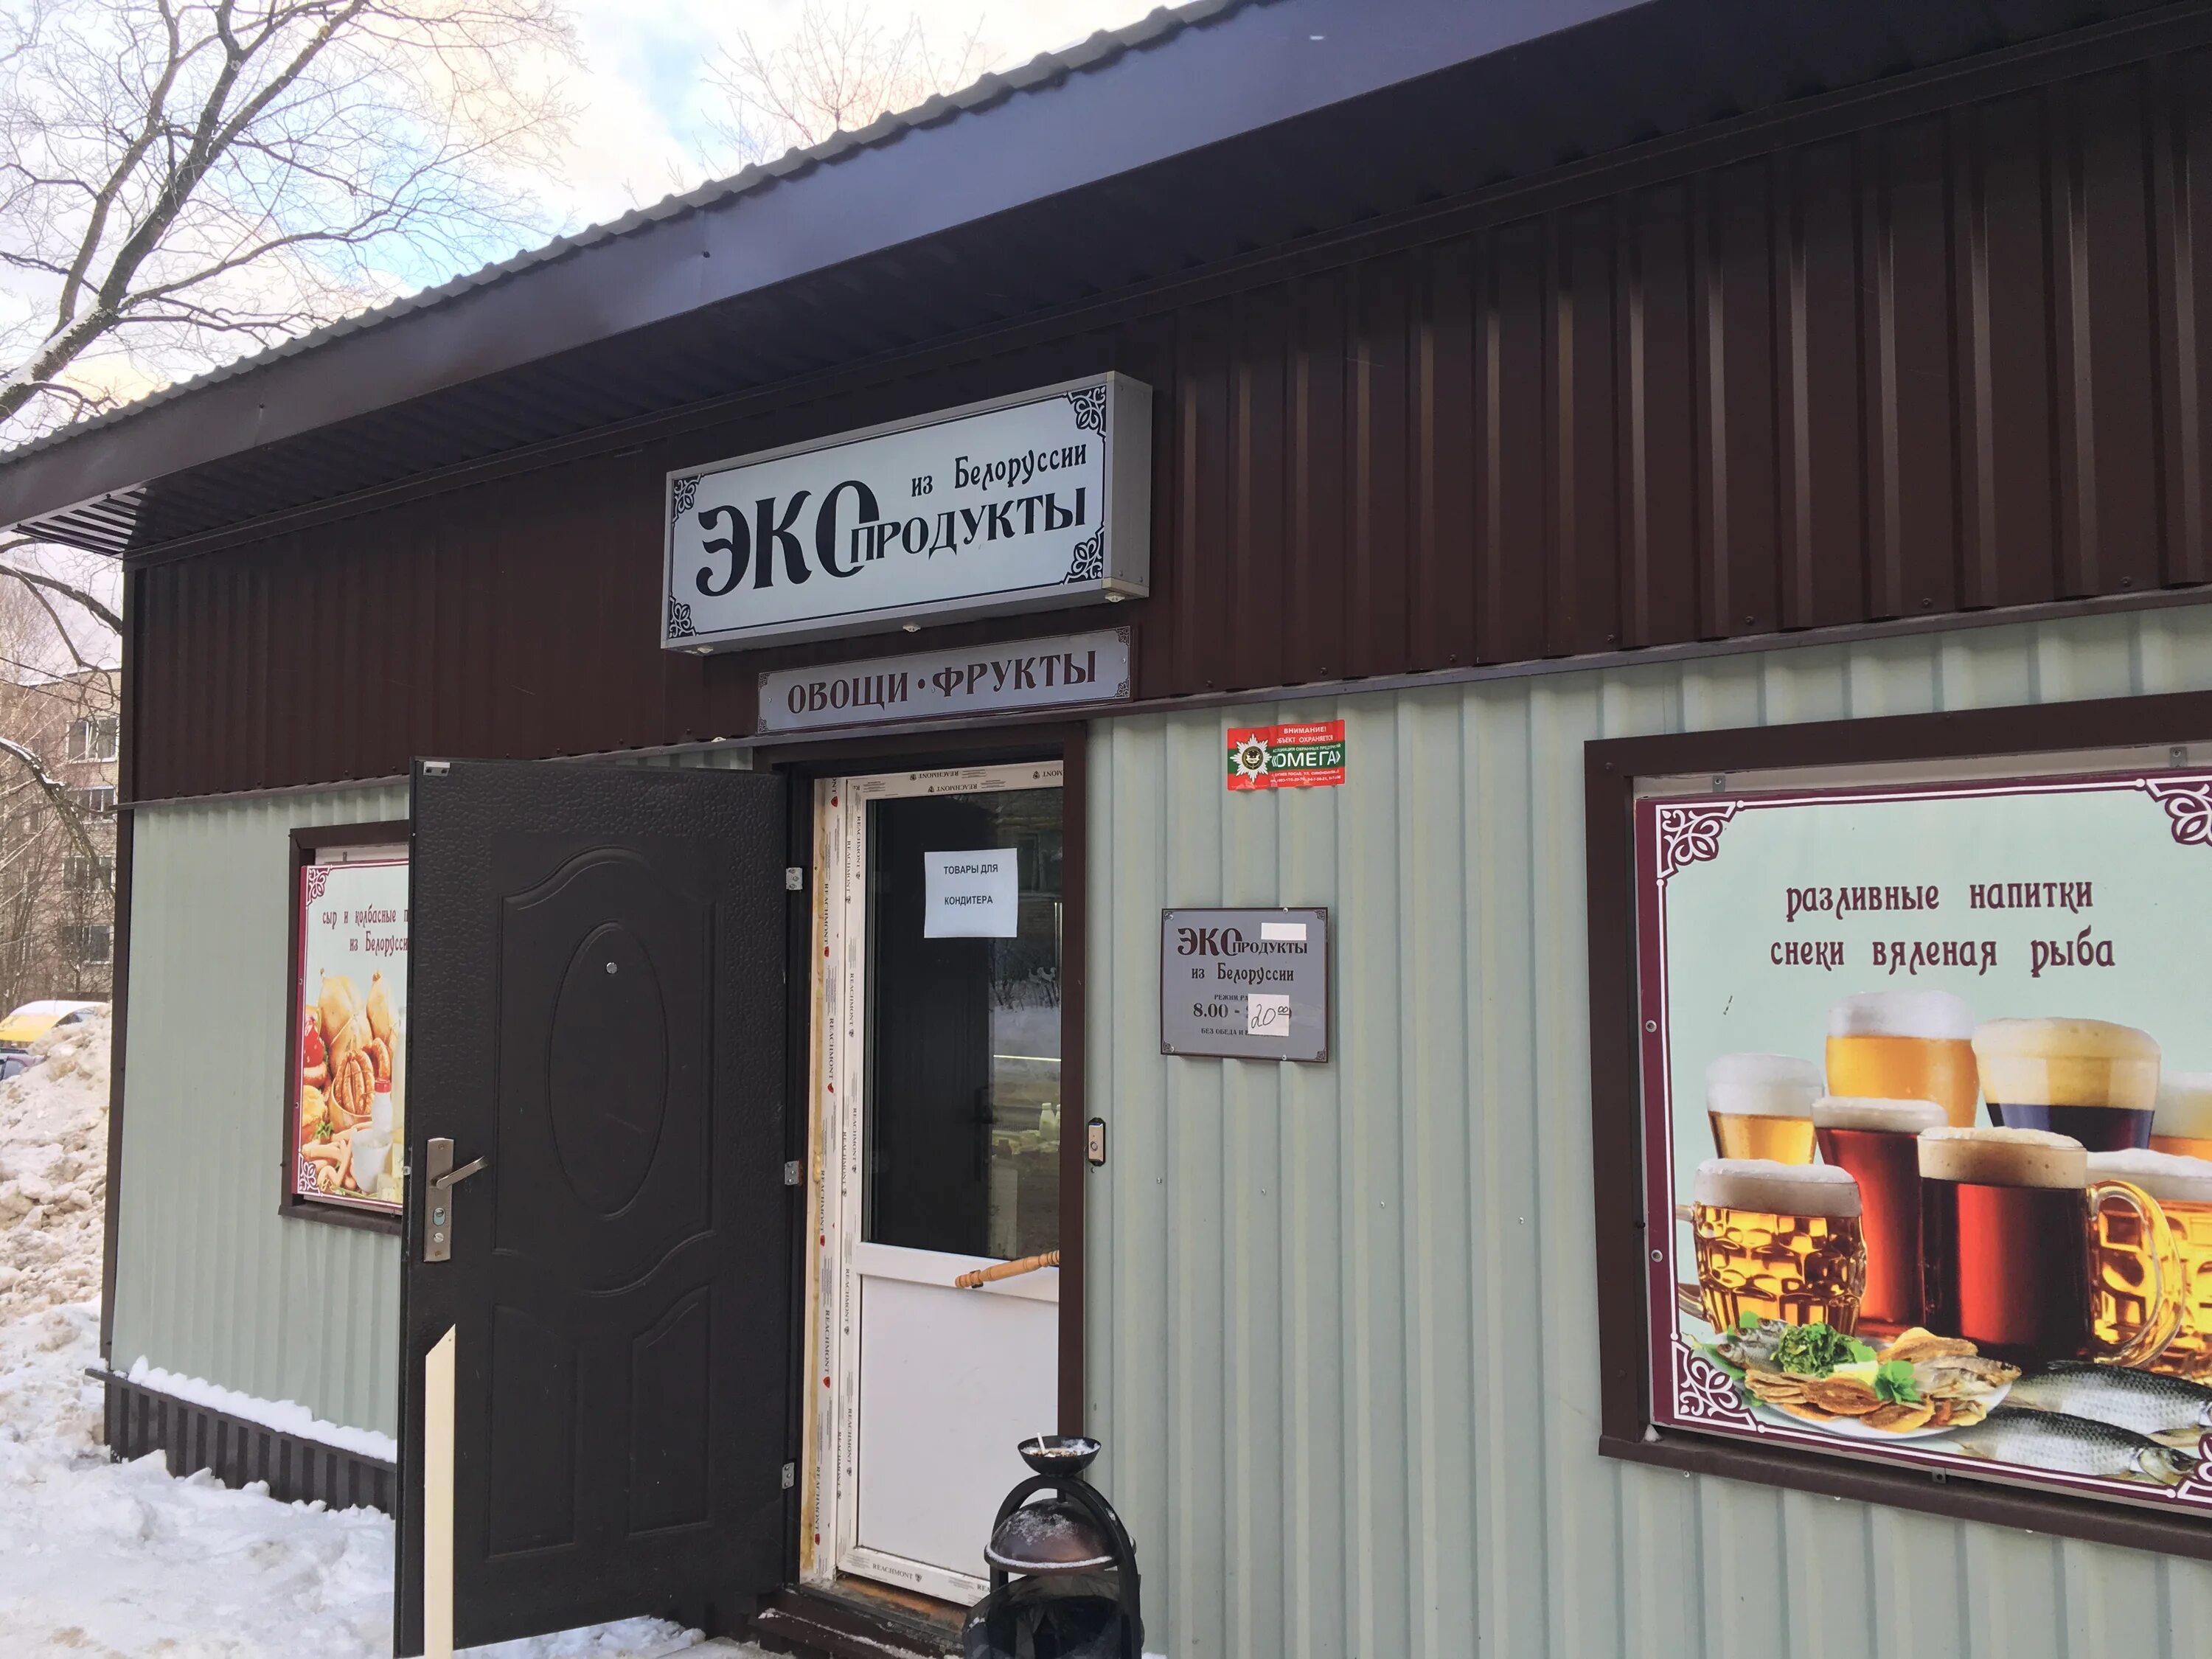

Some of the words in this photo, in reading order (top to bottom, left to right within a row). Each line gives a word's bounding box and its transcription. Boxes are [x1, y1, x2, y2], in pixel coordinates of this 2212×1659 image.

[911, 474, 933, 498] из
[954, 444, 1087, 492] Белоруссии
[787, 672, 908, 714] ОВОЩИ
[933, 650, 1097, 698] ФРУКТЫ
[1284, 726, 1326, 734] ВНИМАНИЕ!
[1298, 734, 1333, 743] ОХРАНЯЕТСЯ
[918, 771, 959, 779] REACHMONT
[936, 784, 978, 792] REACHMONT
[944, 865, 978, 874] ТОВАРЫ
[981, 864, 998, 874] ДЛЯ
[945, 895, 993, 906] КОНДИТЕРА
[1785, 884, 1940, 922] разливные
[1969, 880, 2094, 914] напитки
[322, 911, 337, 930] сыр
[344, 911, 349, 924] и
[355, 903, 397, 928] колбасные
[349, 938, 358, 952] из
[365, 931, 408, 957] Белорусси
[1770, 940, 1846, 972] снеки
[1872, 940, 1997, 975] вяленая
[2030, 925, 2116, 978] рыба
[1191, 968, 1205, 979] из
[1217, 962, 1294, 985] Белоруссии
[1193, 1003, 1228, 1018] 8.00
[872, 1563, 914, 1581] REACHMONT
